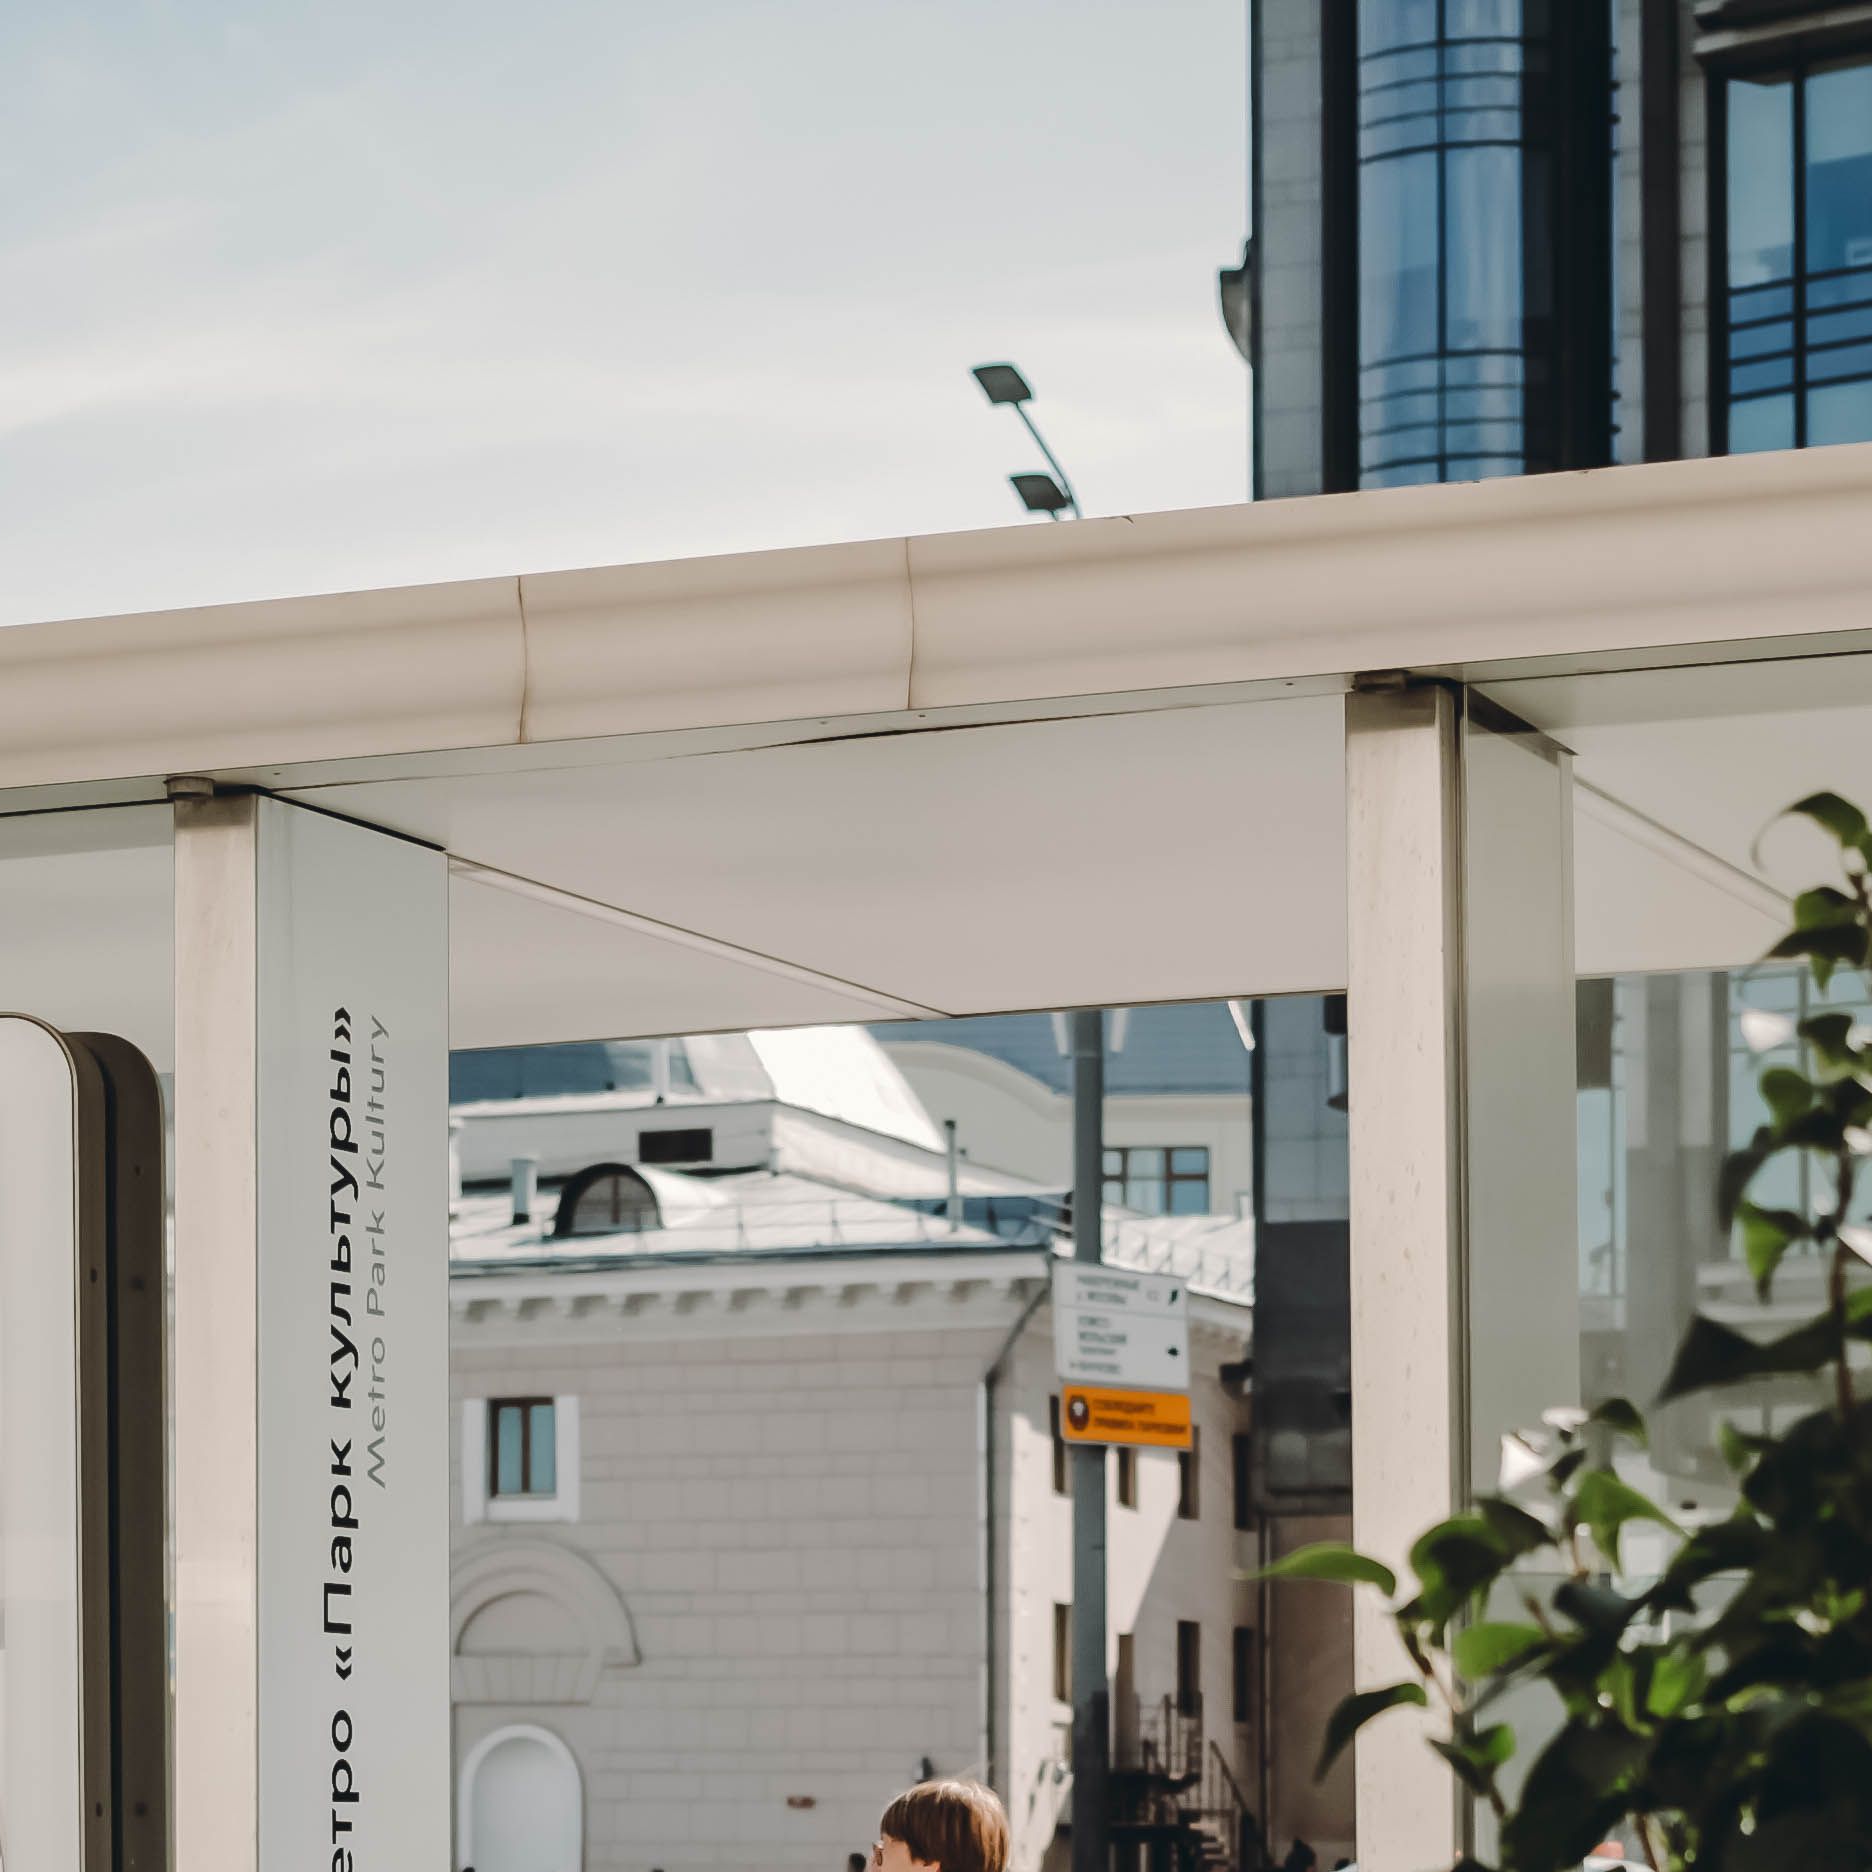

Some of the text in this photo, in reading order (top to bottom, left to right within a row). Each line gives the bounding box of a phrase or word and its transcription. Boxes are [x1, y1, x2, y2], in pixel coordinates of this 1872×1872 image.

[328, 1005, 360, 1409] культуры»
[365, 1014, 391, 1490] Metro Park Kultury
[322, 1437, 360, 1682] «Парк
